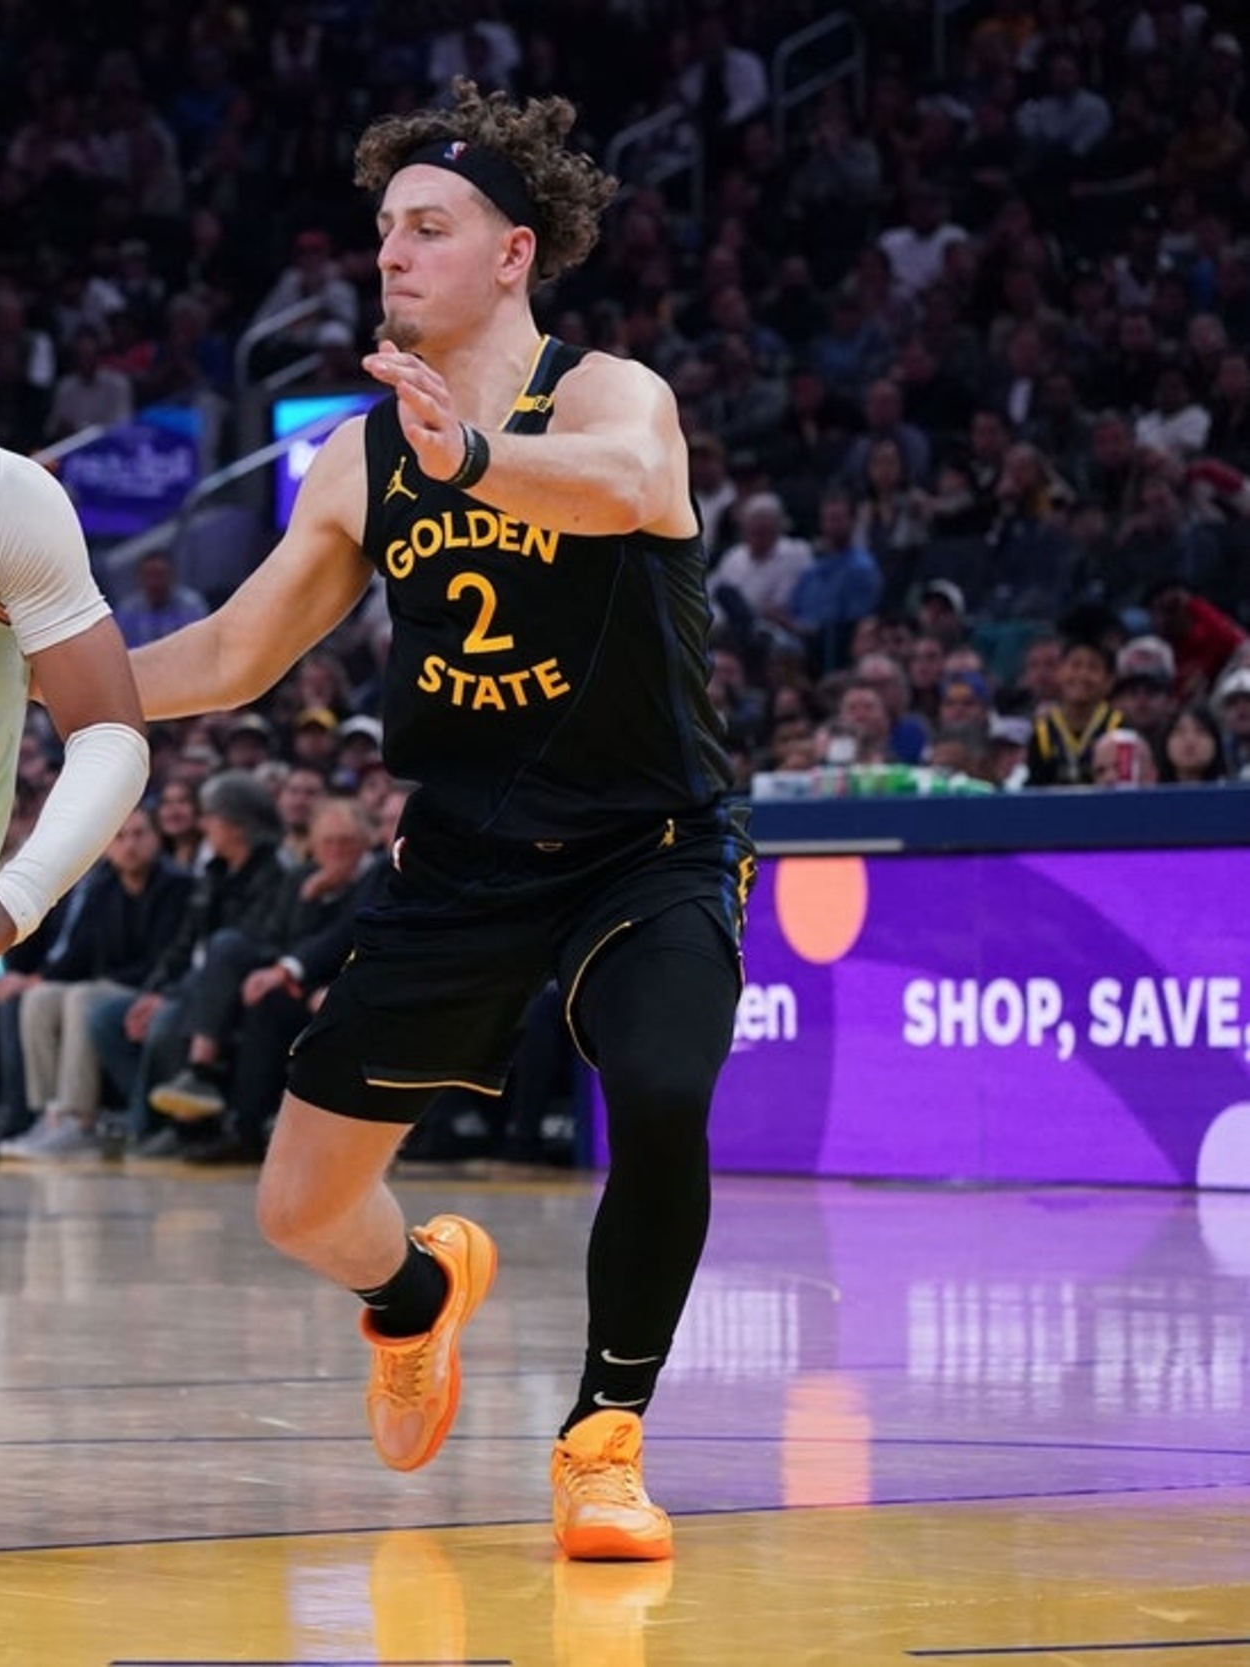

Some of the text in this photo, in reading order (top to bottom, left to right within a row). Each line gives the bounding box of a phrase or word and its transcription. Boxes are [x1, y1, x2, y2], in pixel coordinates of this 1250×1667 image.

[386, 510, 560, 579] GOLDEN
[447, 572, 514, 654] 2
[417, 655, 571, 711] STATE
[733, 982, 798, 1041] en
[903, 978, 1077, 1061] SHOP,
